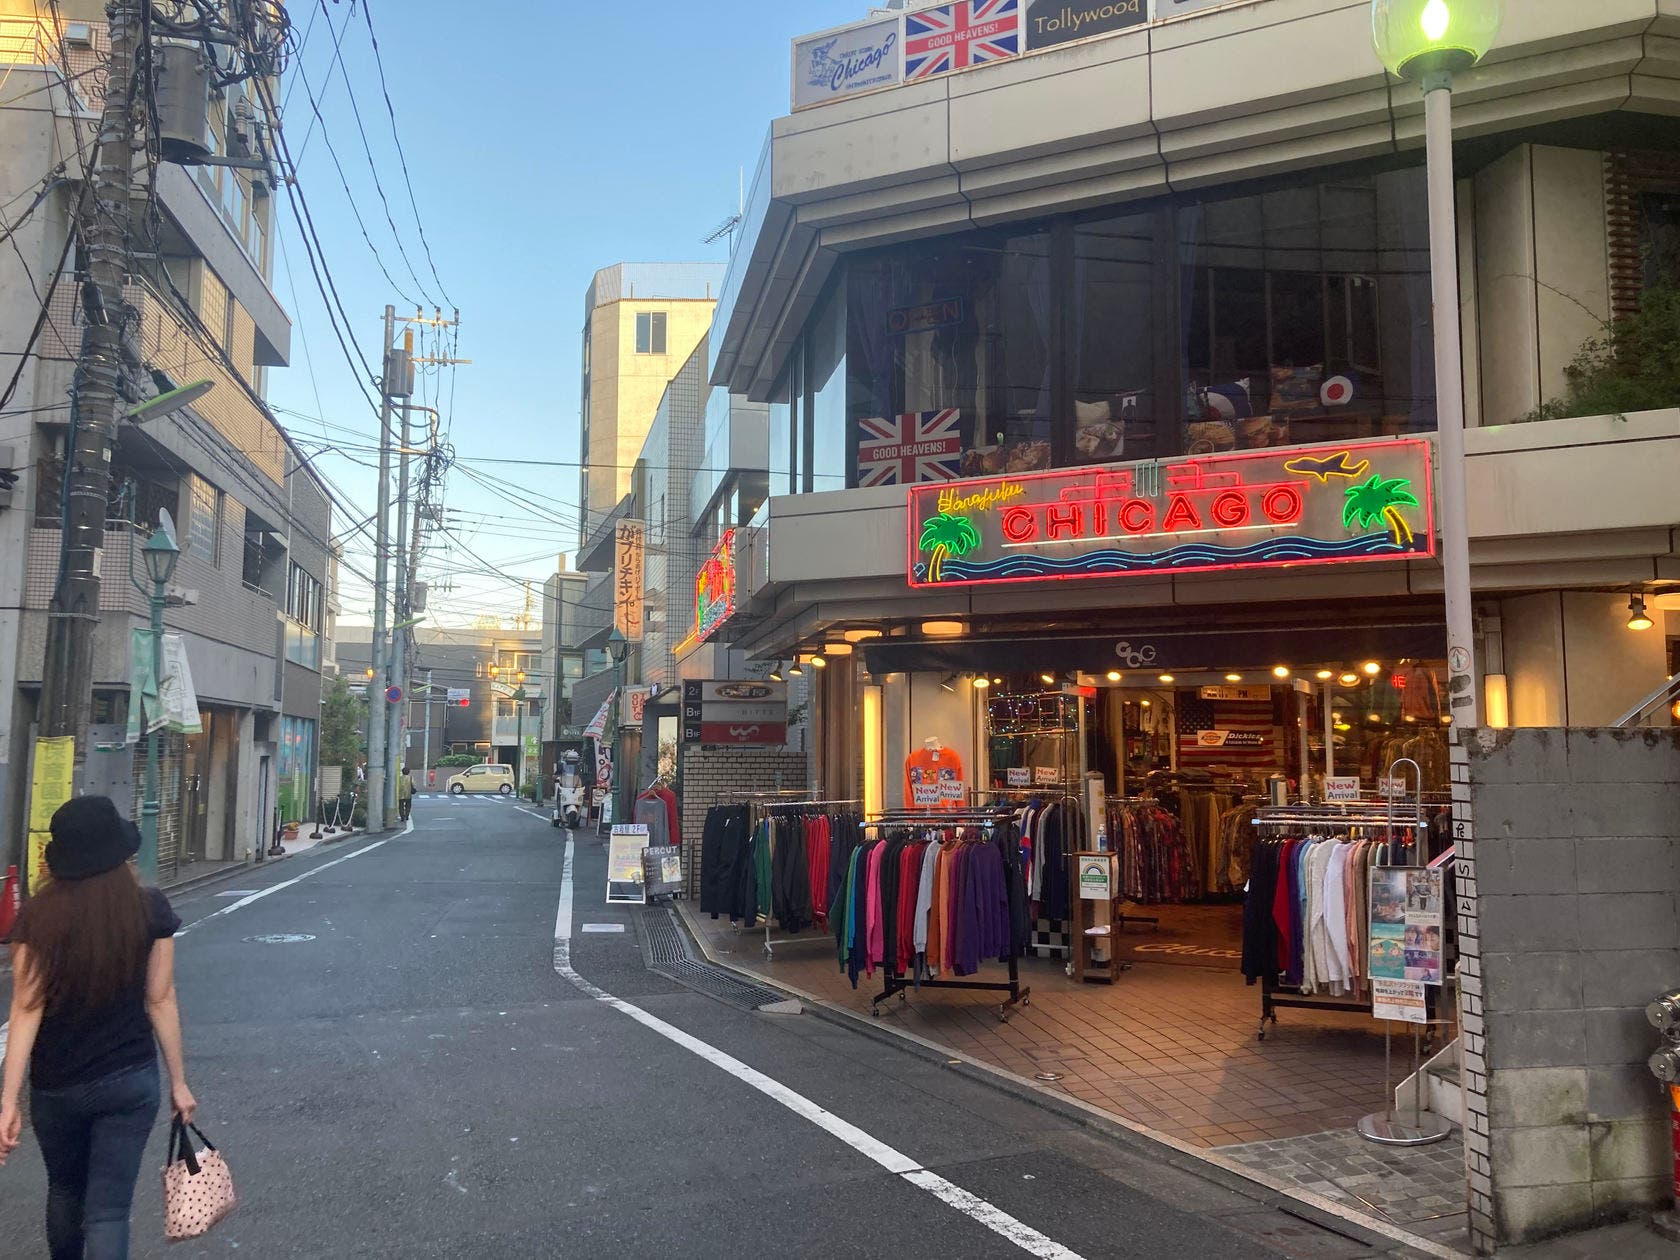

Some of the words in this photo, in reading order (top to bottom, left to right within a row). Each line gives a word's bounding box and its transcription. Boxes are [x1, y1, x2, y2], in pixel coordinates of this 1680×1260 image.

[1034, 0, 1139, 33] Tollywood
[928, 34, 952, 48] GOOD
[954, 25, 998, 42] HEAVENS!
[831, 32, 896, 91] Chicago
[873, 449, 897, 459] GOOD
[901, 442, 946, 456] HEAVENS!
[1002, 486, 1302, 542] CHICAGO
[940, 783, 960, 791] New
[1327, 782, 1354, 790] New
